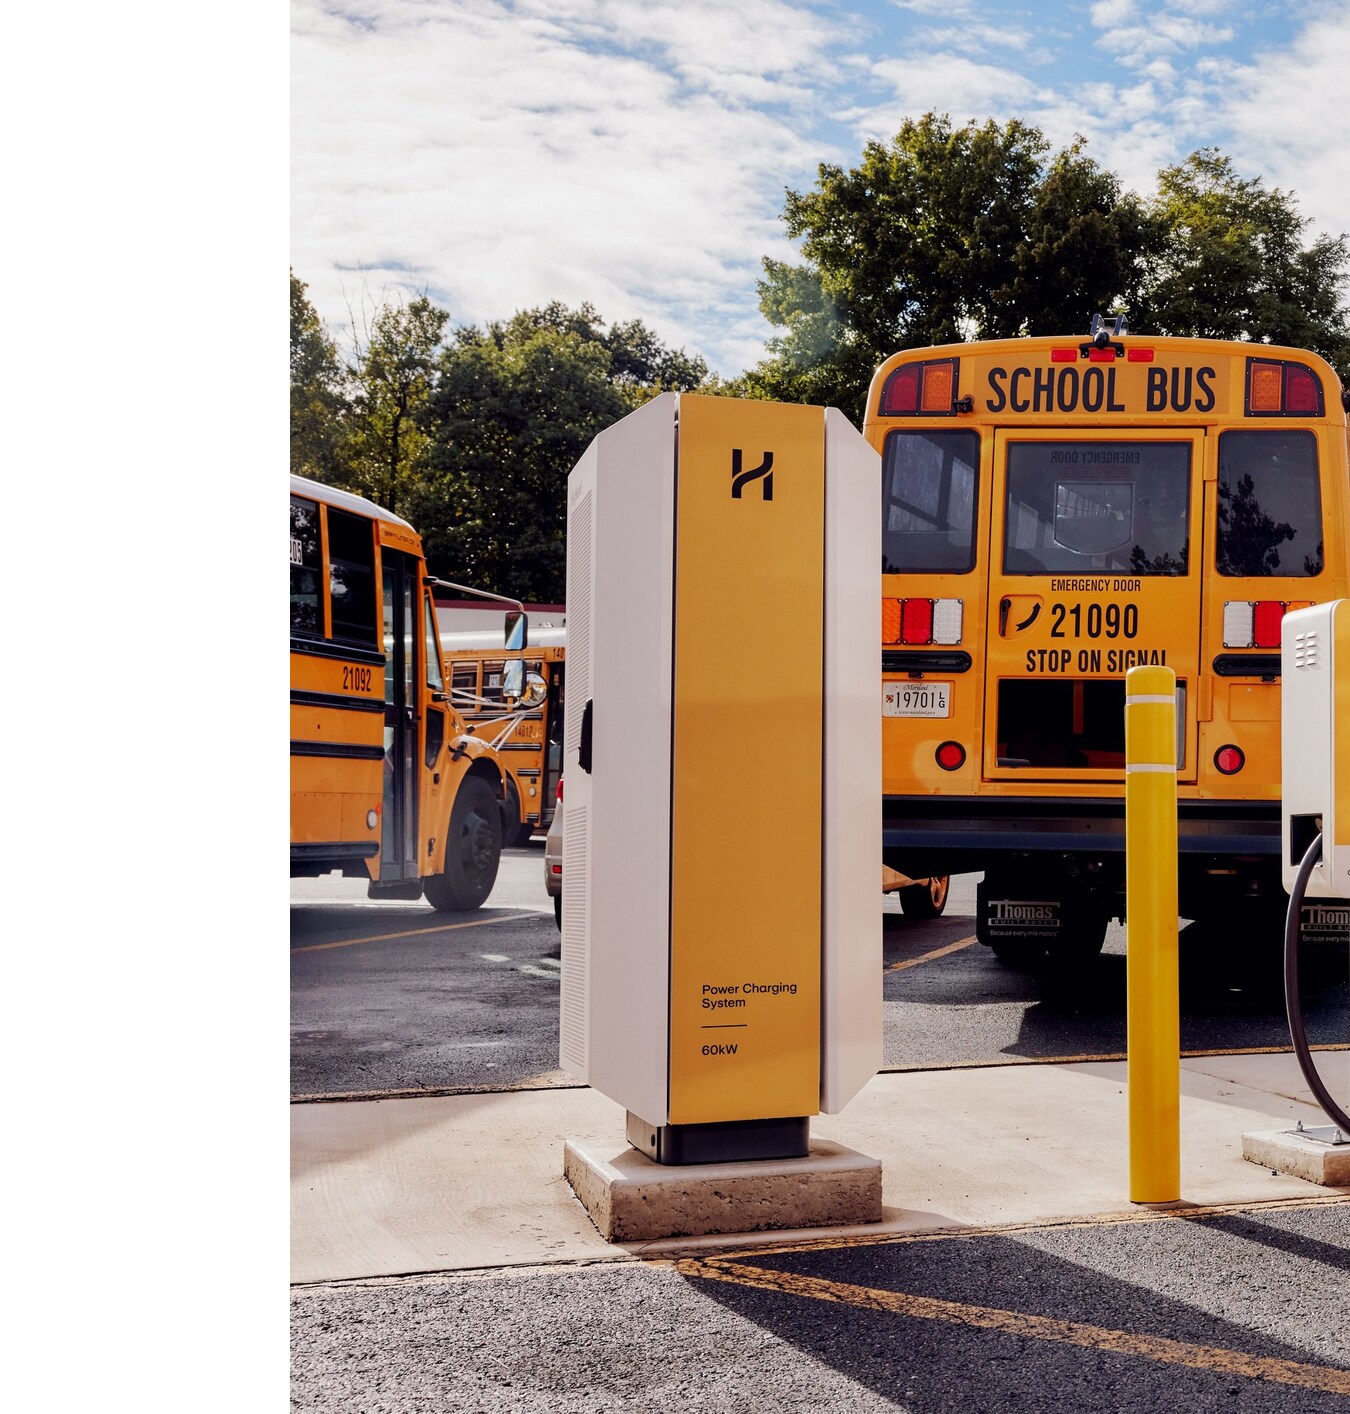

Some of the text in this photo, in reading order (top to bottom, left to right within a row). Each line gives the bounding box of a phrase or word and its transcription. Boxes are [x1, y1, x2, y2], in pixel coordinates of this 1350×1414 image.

[986, 367, 1216, 412] SCHOOL BUS
[1051, 579, 1141, 592] EMERGENCY DOOR
[1051, 603, 1138, 638] 21090
[1026, 649, 1072, 672] STOP
[1078, 649, 1100, 672] ON
[343, 666, 372, 692] 21092
[896, 692, 935, 708] 19701
[988, 899, 1060, 918] Thomas
[1301, 904, 1350, 924] Thom
[702, 982, 797, 995] Power Charging
[702, 998, 746, 1010] System
[702, 1044, 738, 1055] 60kW
